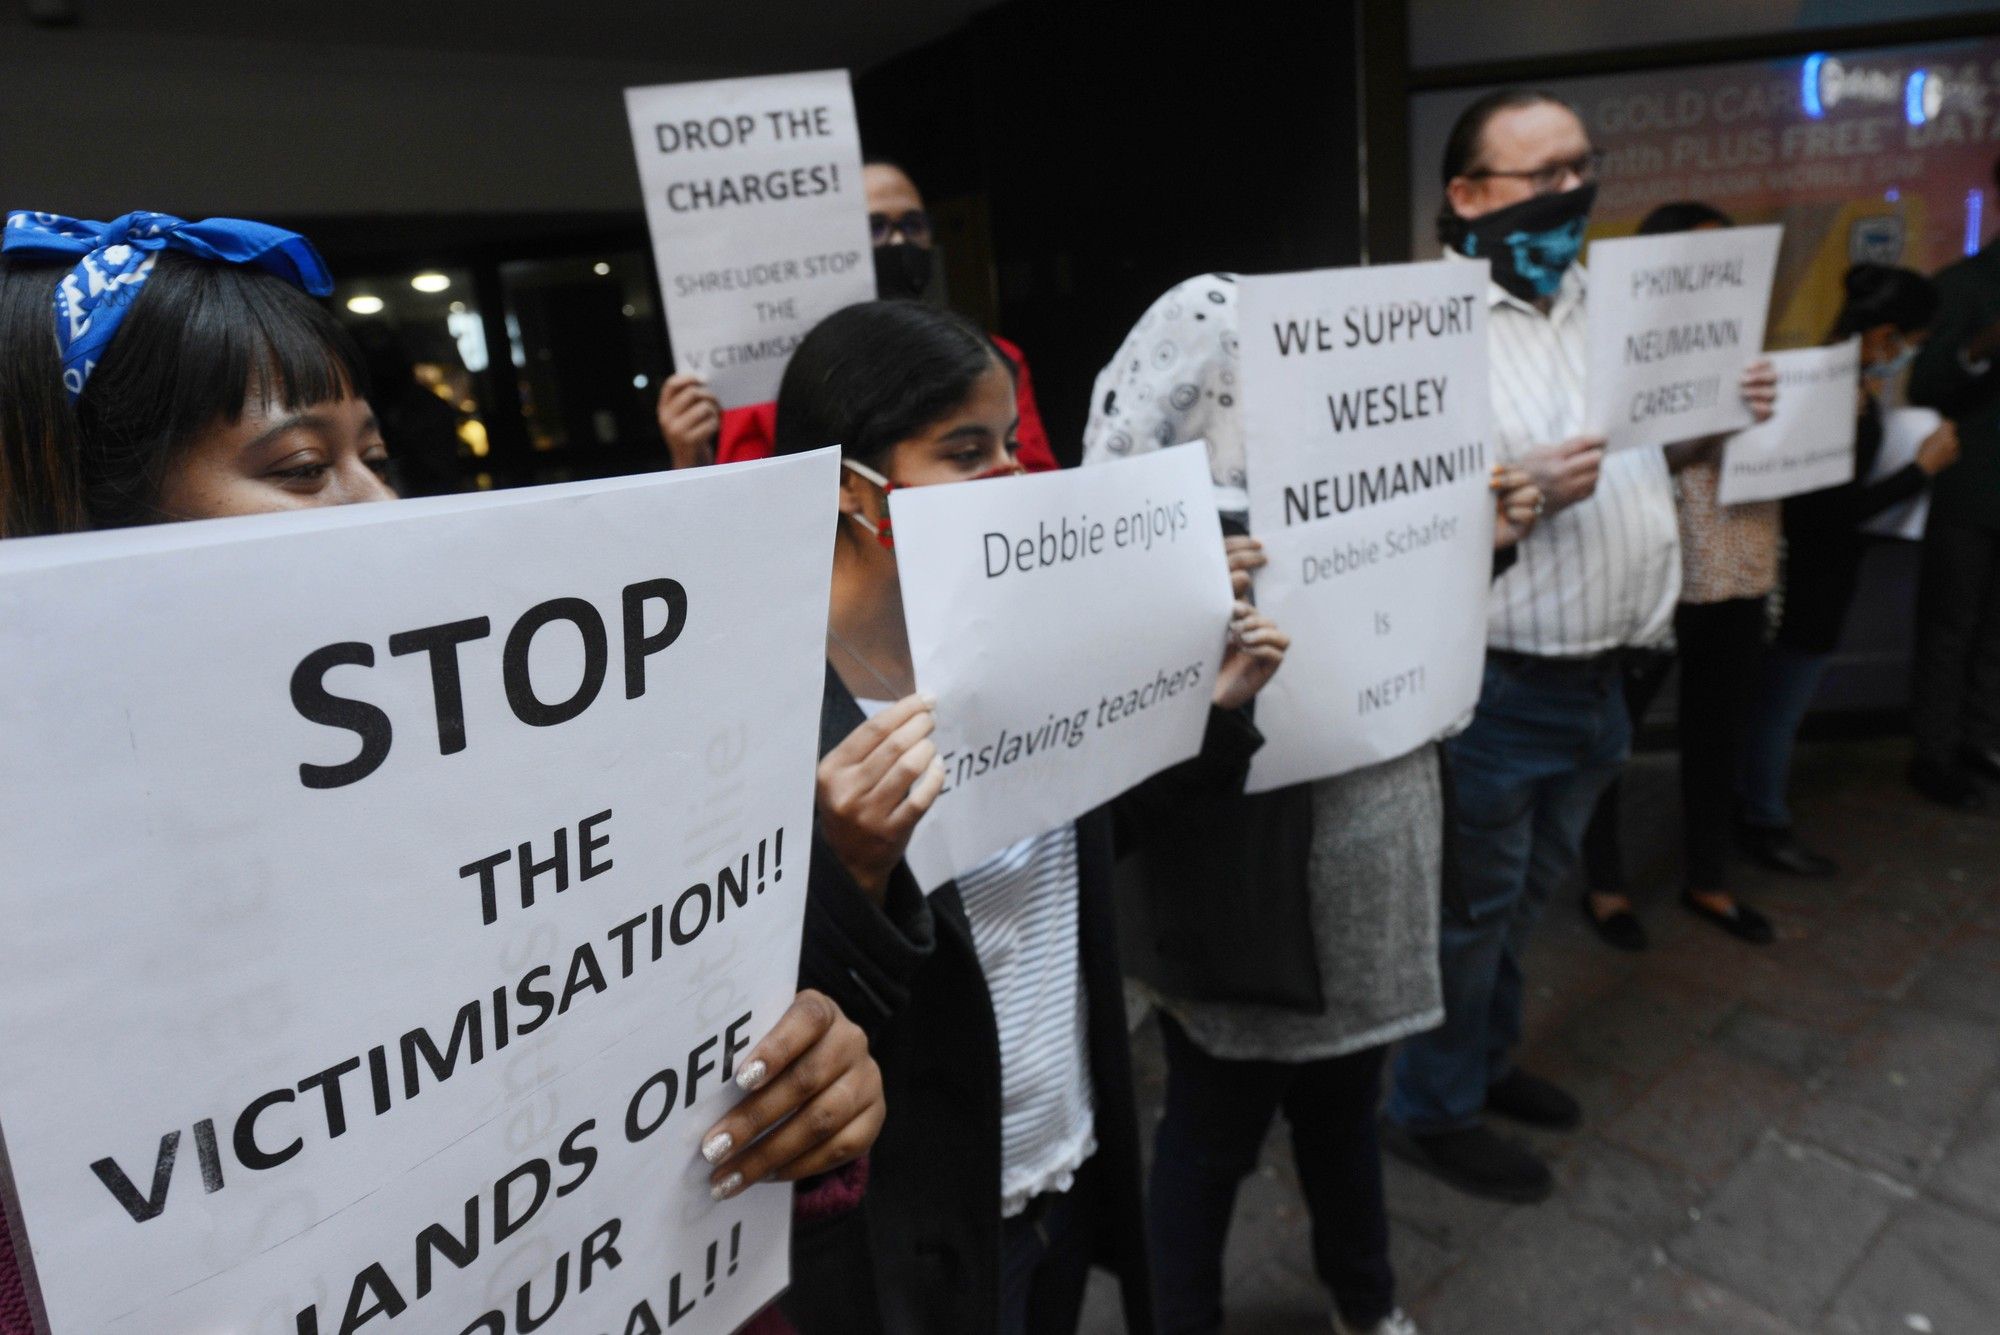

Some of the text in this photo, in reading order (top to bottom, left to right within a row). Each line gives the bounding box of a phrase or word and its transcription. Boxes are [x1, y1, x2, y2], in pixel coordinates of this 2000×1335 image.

[655, 106, 832, 154] DROP THE
[667, 163, 841, 213] CHARGES!
[673, 250, 861, 298] SHREUDER STOP
[755, 297, 797, 323] THE
[1273, 294, 1475, 356] WE SUPPORT
[1625, 318, 1742, 365] NEUMANN
[1327, 375, 1448, 434] WESLEY
[983, 498, 1189, 579] Debbie enjoys
[1301, 513, 1460, 586] Debbie Schafer
[1373, 610, 1392, 636] Is
[290, 578, 687, 789] STOP
[1096, 661, 1204, 729] teachers
[1356, 665, 1426, 716] INEPT!
[460, 809, 613, 925] THE
[90, 828, 783, 1222] VICTIMISATION!!
[625, 1011, 752, 1143] OFF
